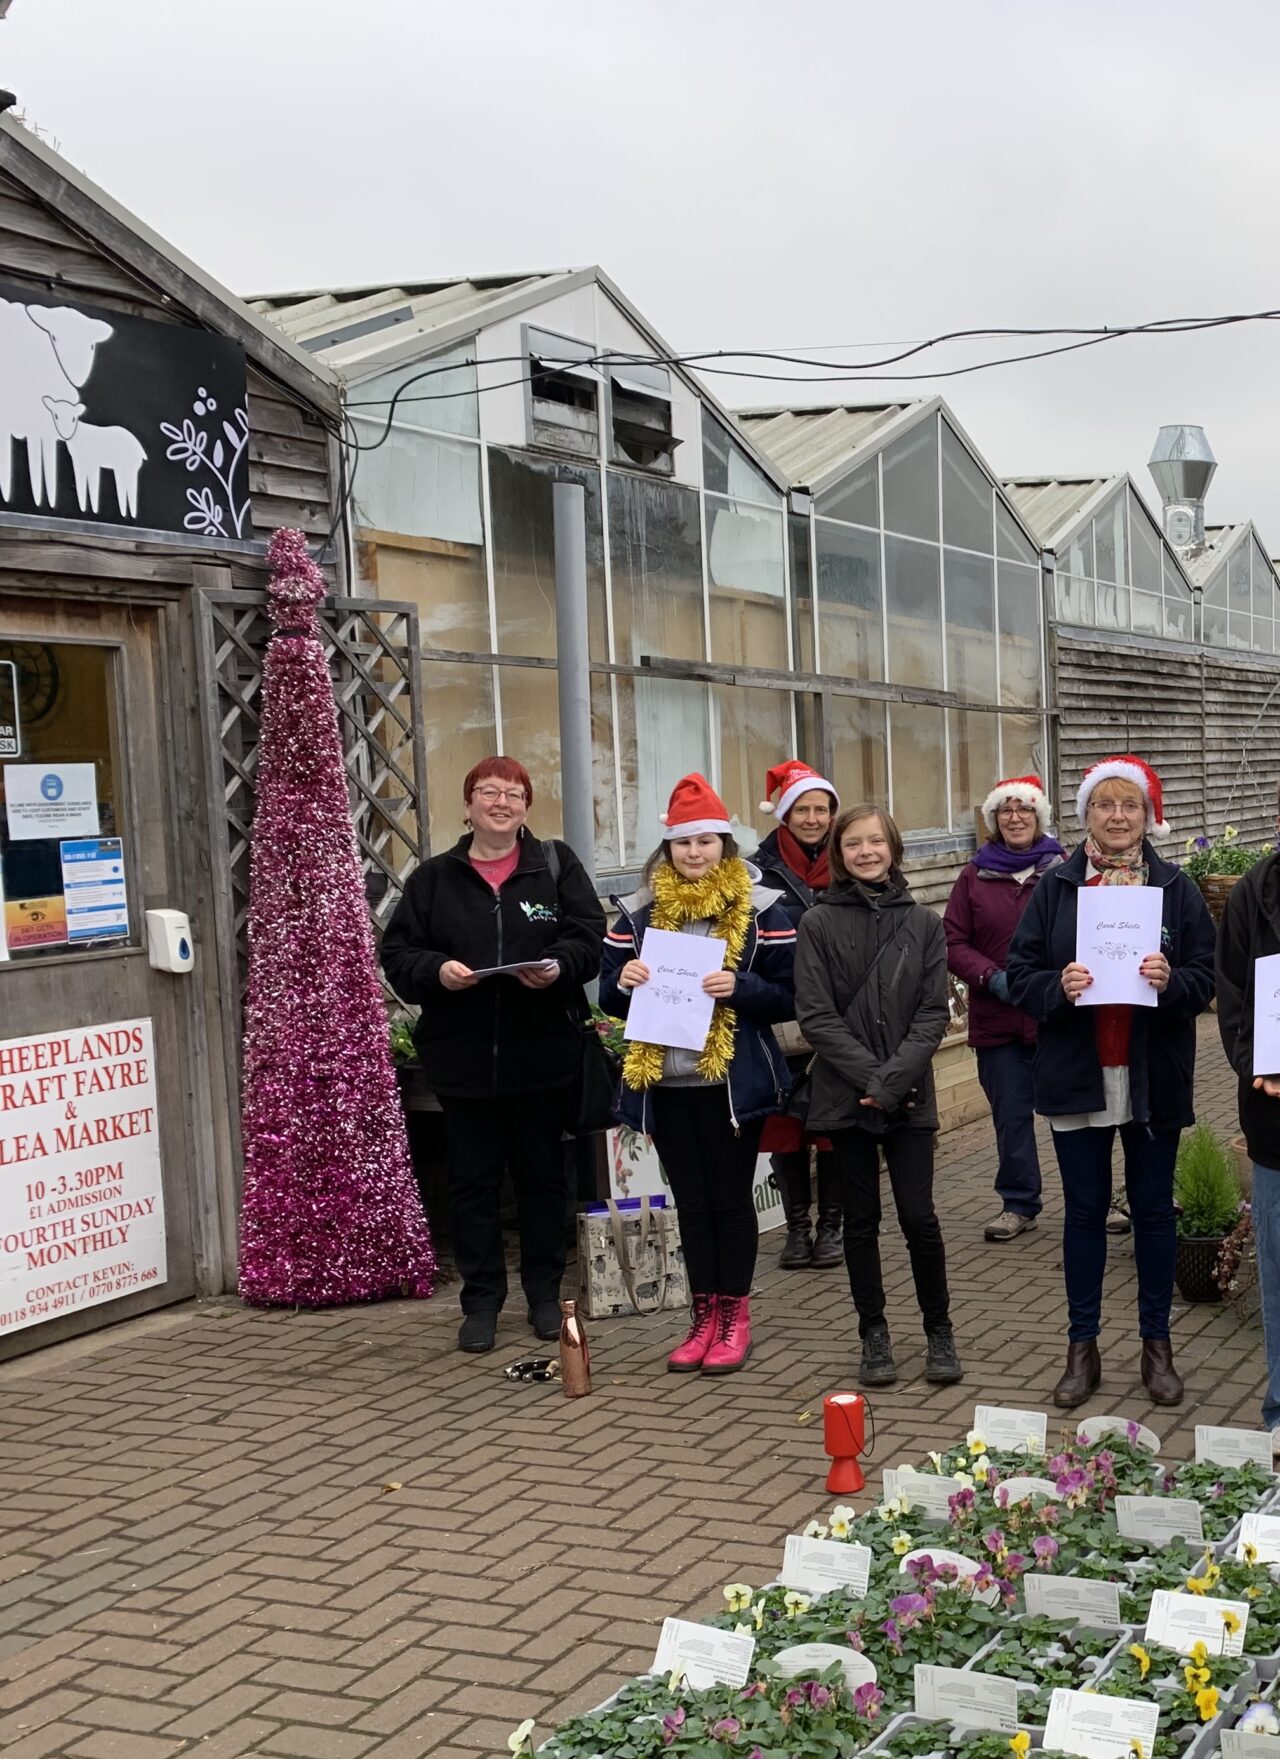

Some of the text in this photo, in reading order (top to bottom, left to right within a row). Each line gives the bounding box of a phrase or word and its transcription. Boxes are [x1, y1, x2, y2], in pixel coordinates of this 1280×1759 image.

[0, 1027, 143, 1076] HEEPLANDS
[0, 1059, 148, 1111] RAFT FAYRE
[65, 1101, 77, 1120] &
[0, 1108, 153, 1166] LEA MARKET
[25, 1181, 45, 1202] 10
[29, 1185, 122, 1219] £1 ADMISSION
[0, 1196, 156, 1253] OURTH SUNDAY
[26, 1224, 130, 1271] MONTHLY
[0, 1308, 27, 1326] 0118
[30, 1302, 49, 1316] 934
[52, 1293, 76, 1310] 4911
[89, 1282, 113, 1298] 0770
[115, 1273, 138, 1290] 8775
[141, 1267, 158, 1282] 668
[26, 1261, 135, 1303] CONTACT KEVIN:
